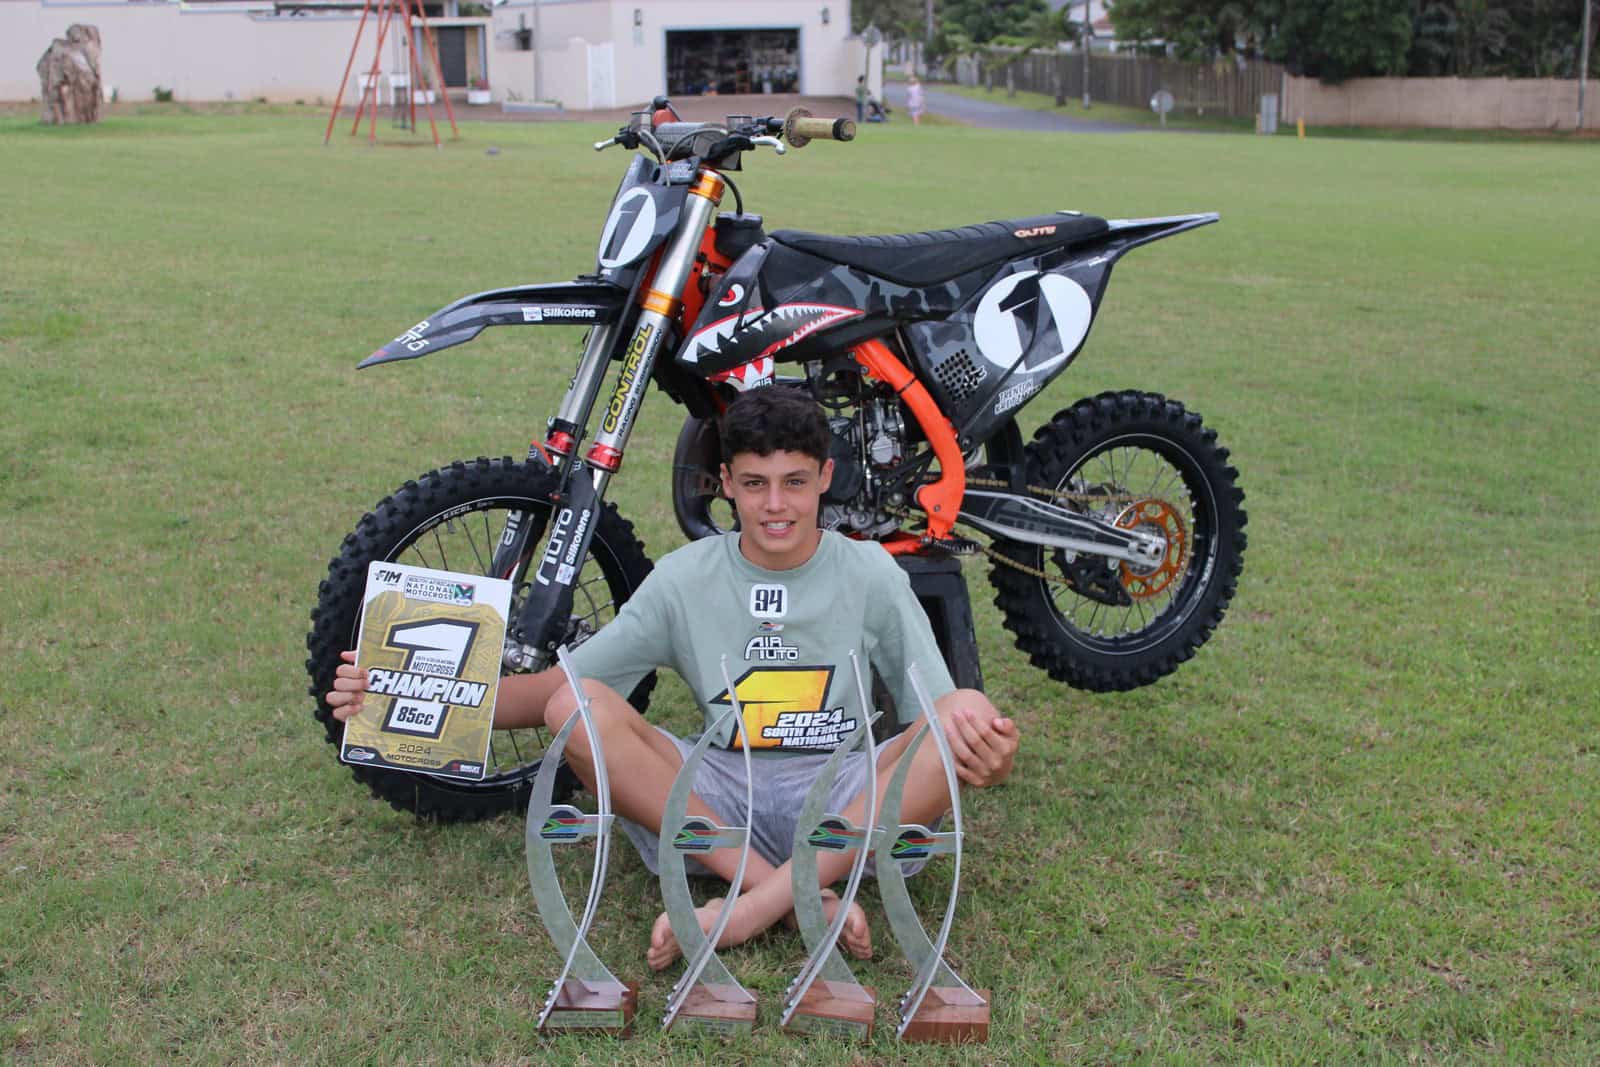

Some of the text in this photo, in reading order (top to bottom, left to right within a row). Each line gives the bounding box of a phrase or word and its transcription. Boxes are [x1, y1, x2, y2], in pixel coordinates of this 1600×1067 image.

[602, 193, 649, 261] 1
[543, 307, 596, 318] Silkolene
[998, 273, 1064, 371] 1
[604, 323, 653, 434] CONTROL
[618, 396, 637, 438] RACING
[565, 508, 592, 565] Silkolene
[374, 569, 403, 584] FIM
[406, 588, 454, 601] MOTOCROSS
[407, 581, 454, 594] NATIONAL
[755, 589, 783, 613] 94
[411, 661, 456, 676] MOTOCROSS
[368, 669, 488, 707] CHAMPION
[396, 706, 435, 726] 85cc
[777, 708, 844, 727] 2024
[763, 719, 856, 738] SOUTH AFRICAN
[398, 743, 432, 755] 2024
[782, 734, 841, 747] NATIONAL
[386, 753, 442, 766] MOTOCROSS
